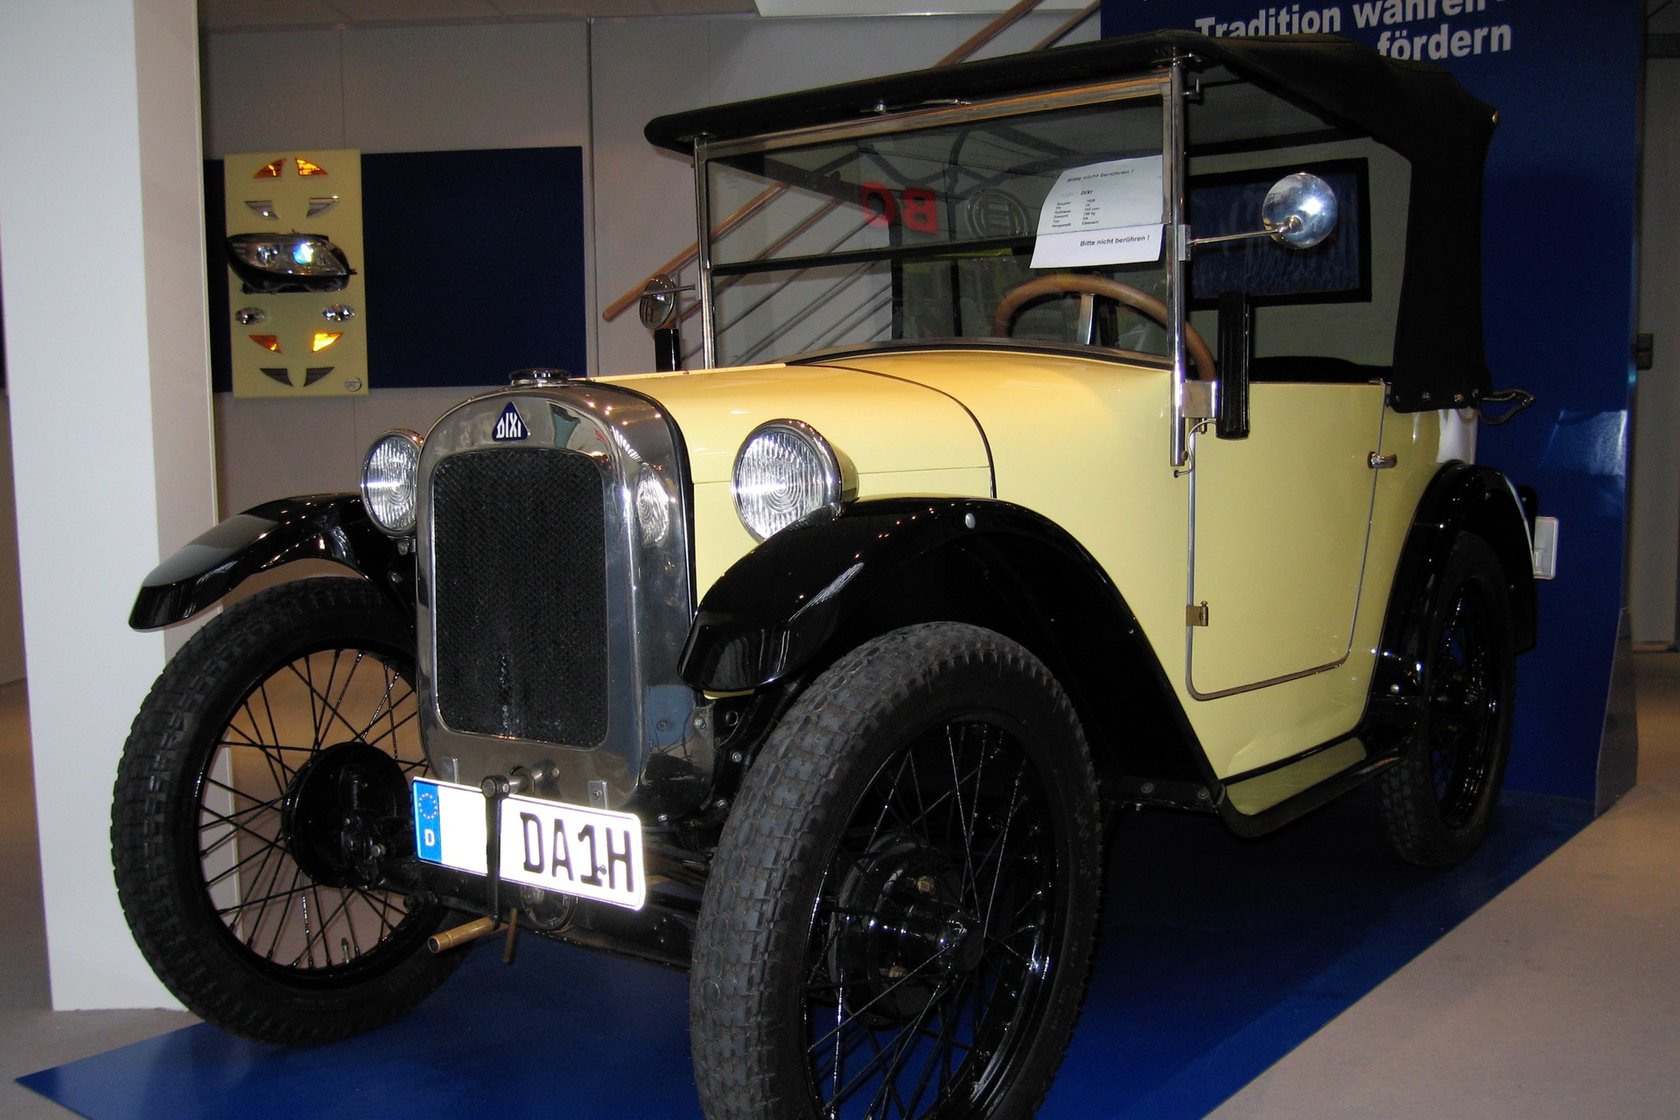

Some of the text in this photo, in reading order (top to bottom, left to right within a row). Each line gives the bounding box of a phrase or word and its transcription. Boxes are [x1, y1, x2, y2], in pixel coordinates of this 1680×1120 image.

[1195, 4, 1341, 38] Tradition
[1377, 24, 1512, 61] fördern
[1096, 238, 1114, 246] nicht
[1115, 236, 1146, 245] berühren
[495, 412, 522, 439] DIXI
[424, 828, 435, 847] D
[519, 811, 635, 893] DA1H
